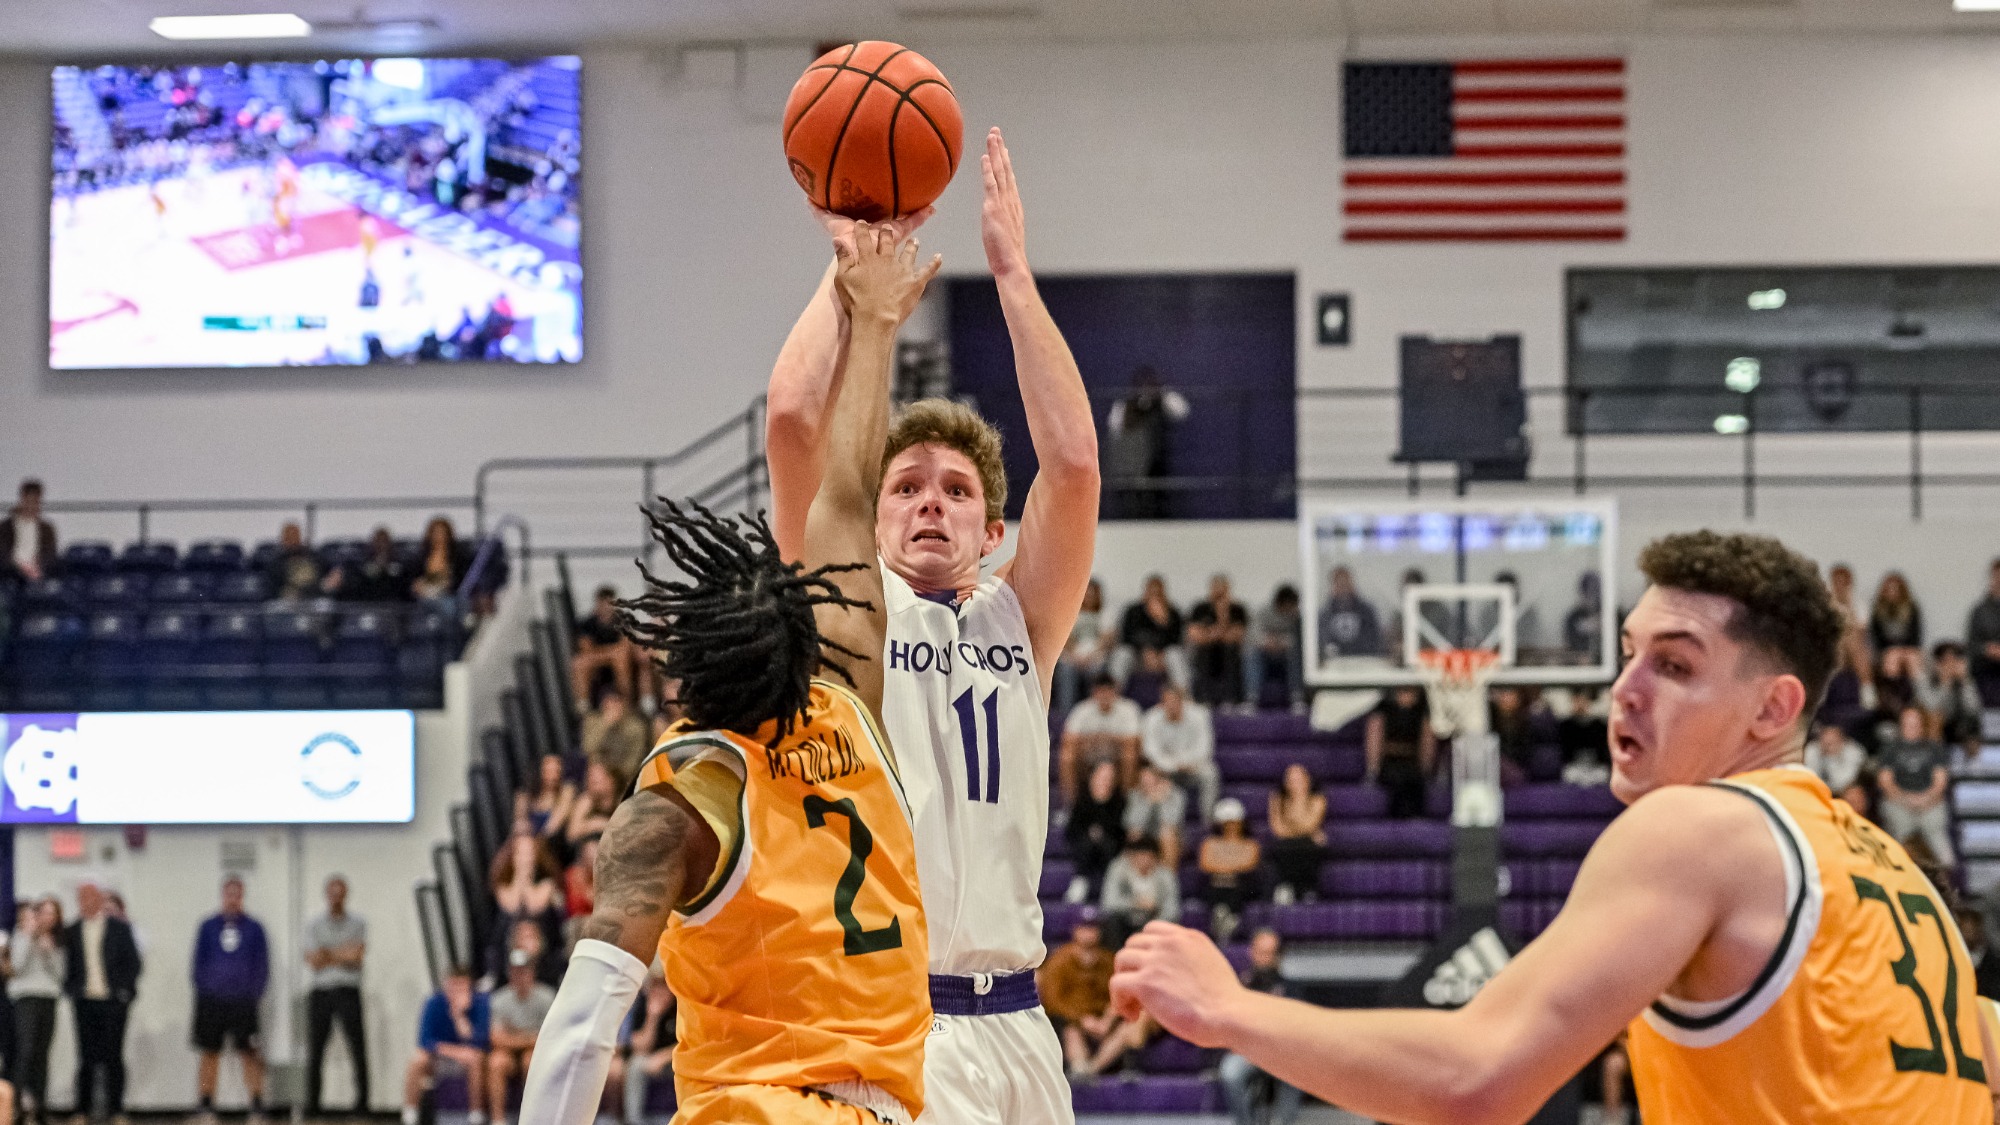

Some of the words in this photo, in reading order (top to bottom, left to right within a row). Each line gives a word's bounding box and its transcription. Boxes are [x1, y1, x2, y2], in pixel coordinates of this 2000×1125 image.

[951, 684, 1001, 804] 11
[803, 794, 903, 956] 2
[1850, 873, 1988, 1084] 32
